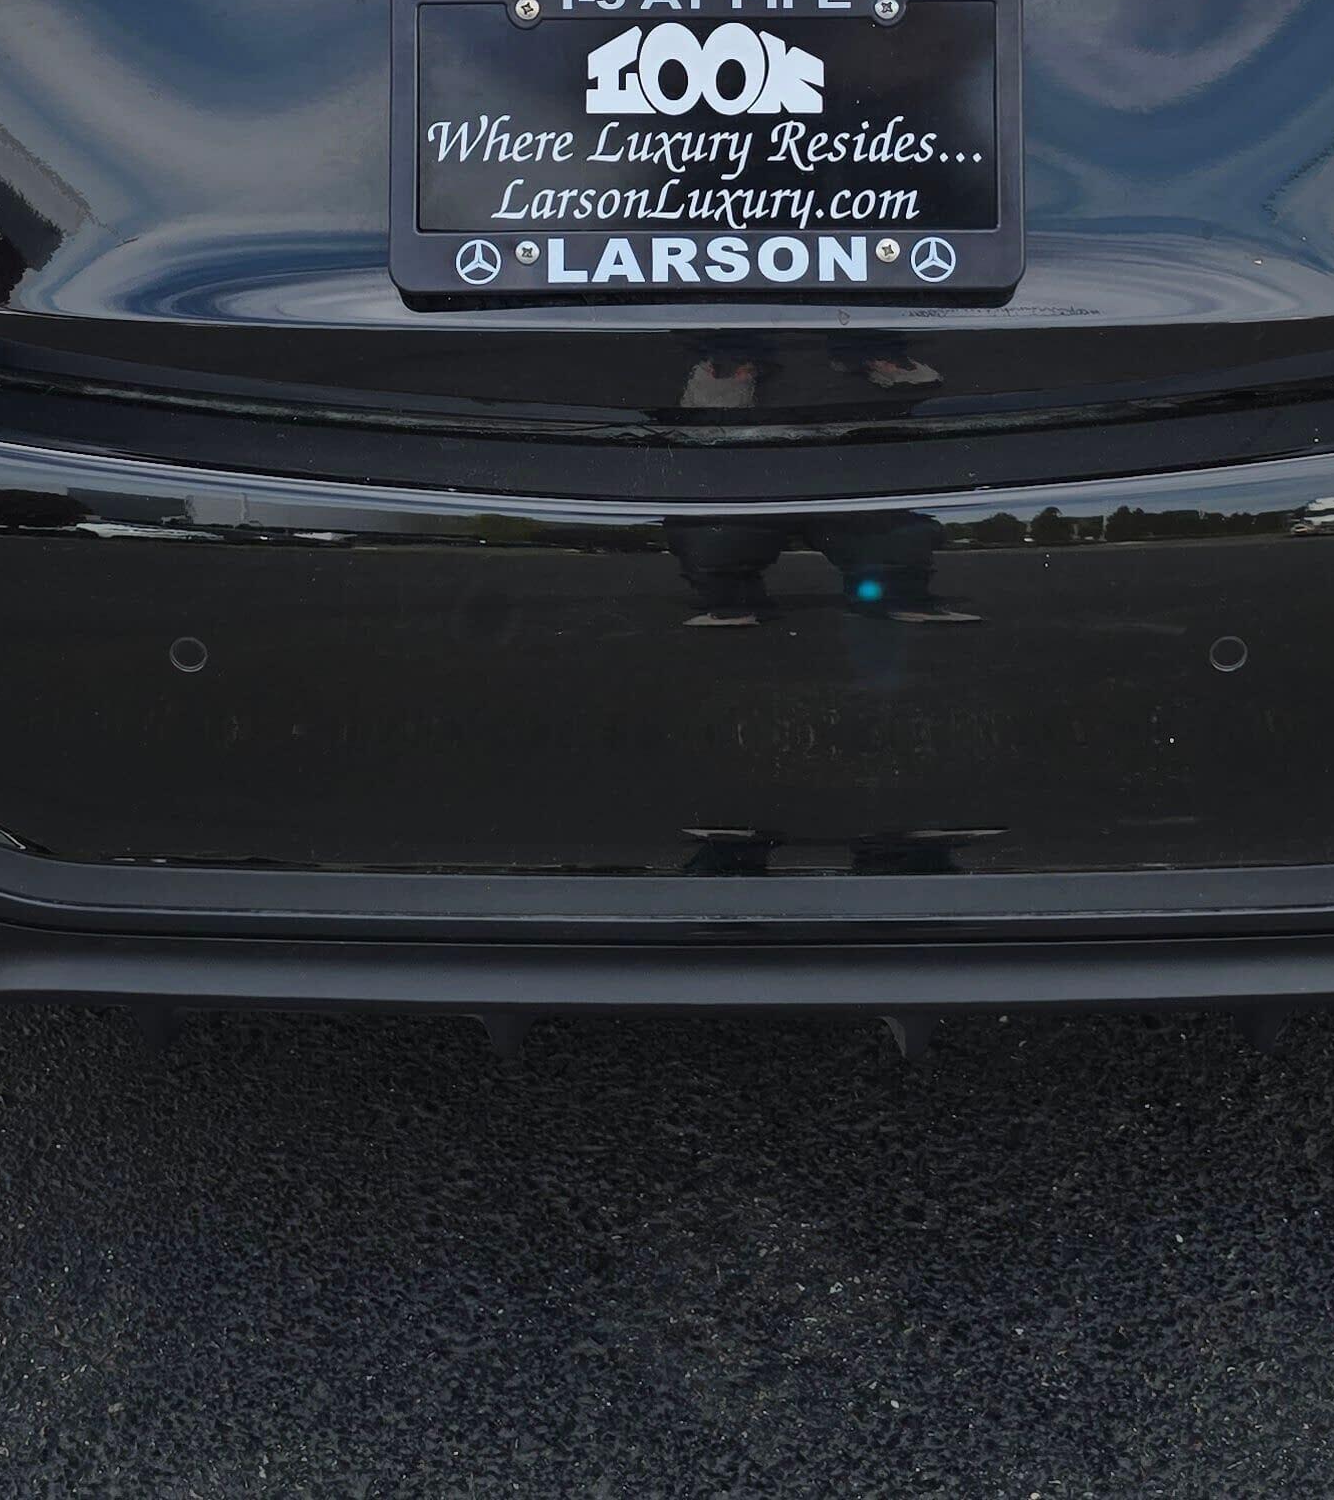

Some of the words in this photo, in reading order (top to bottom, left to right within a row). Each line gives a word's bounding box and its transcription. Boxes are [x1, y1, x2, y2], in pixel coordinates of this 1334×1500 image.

[428, 115, 573, 162] Where
[587, 120, 753, 180] Luxury
[768, 115, 985, 171] Resides...
[490, 178, 921, 229] LarsonLuxury.com
[548, 237, 867, 283] LARSON
